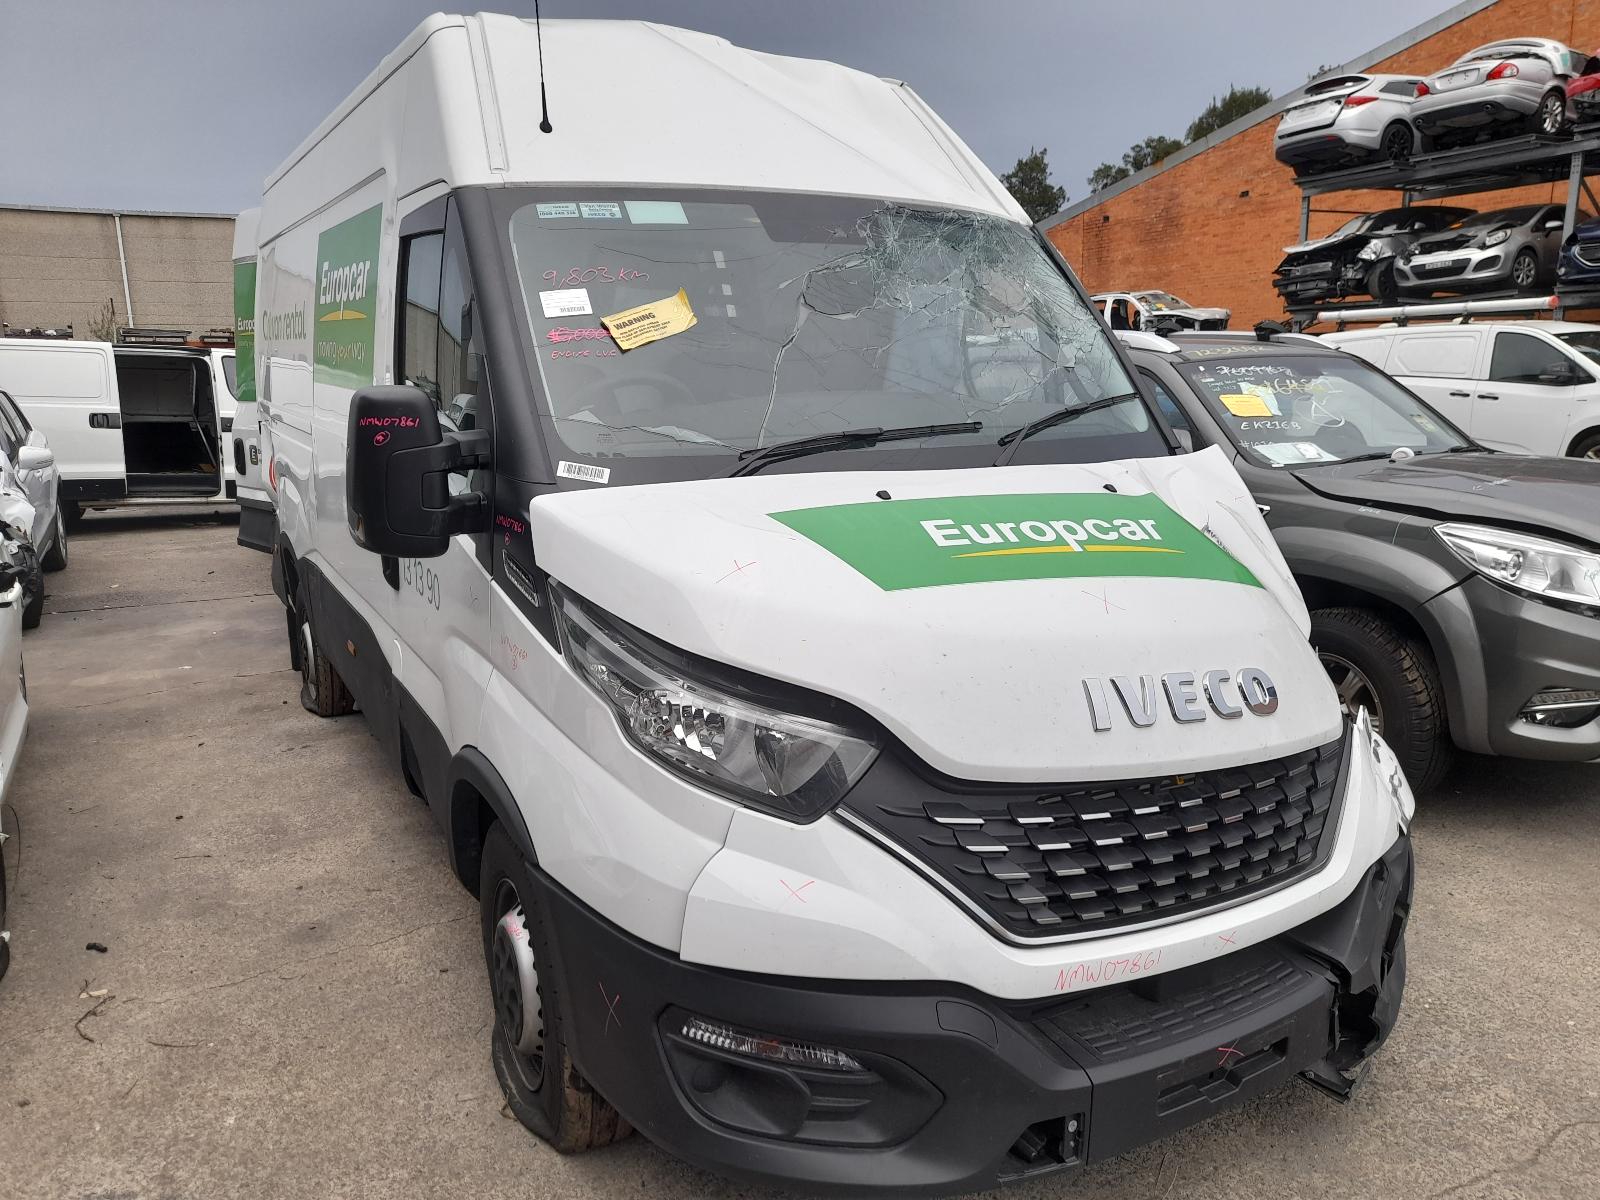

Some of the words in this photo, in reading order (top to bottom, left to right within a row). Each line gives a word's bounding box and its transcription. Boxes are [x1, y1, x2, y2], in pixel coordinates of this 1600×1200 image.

[319, 260, 370, 320] Europcar
[542, 266, 616, 288] 9,803
[613, 312, 656, 331] WARNING
[359, 416, 420, 428] NMW07861
[919, 515, 1163, 552] Europcar
[426, 567, 441, 611] 90
[1081, 667, 1279, 733] IVECO
[1054, 949, 1163, 991] NMW07861
